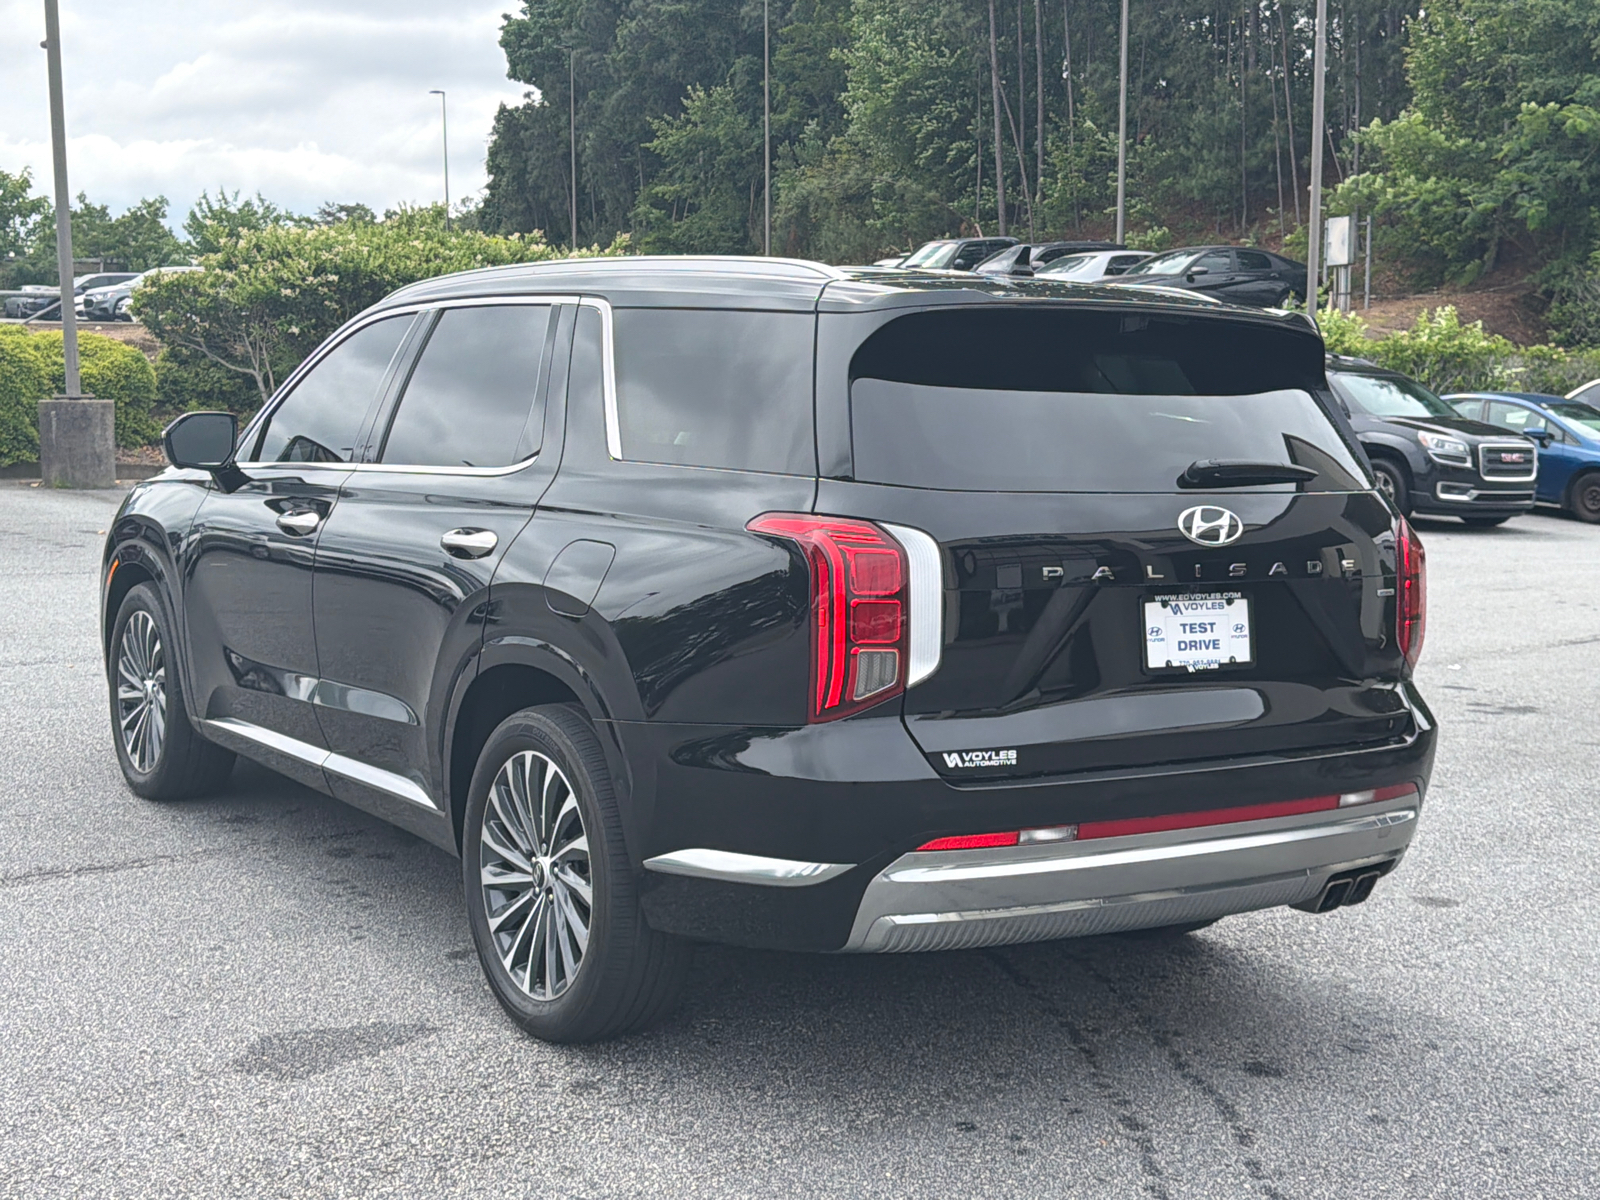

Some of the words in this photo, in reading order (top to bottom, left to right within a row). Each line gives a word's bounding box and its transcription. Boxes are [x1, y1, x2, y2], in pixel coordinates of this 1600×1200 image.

[1042, 558, 1356, 582] PALISADE
[1182, 602, 1225, 611] VOYLES
[1179, 622, 1216, 634] TEST
[1177, 639, 1221, 651] DRIVE
[962, 750, 1017, 761] VOYLES
[963, 759, 1017, 767] AUTOMOTIVE
